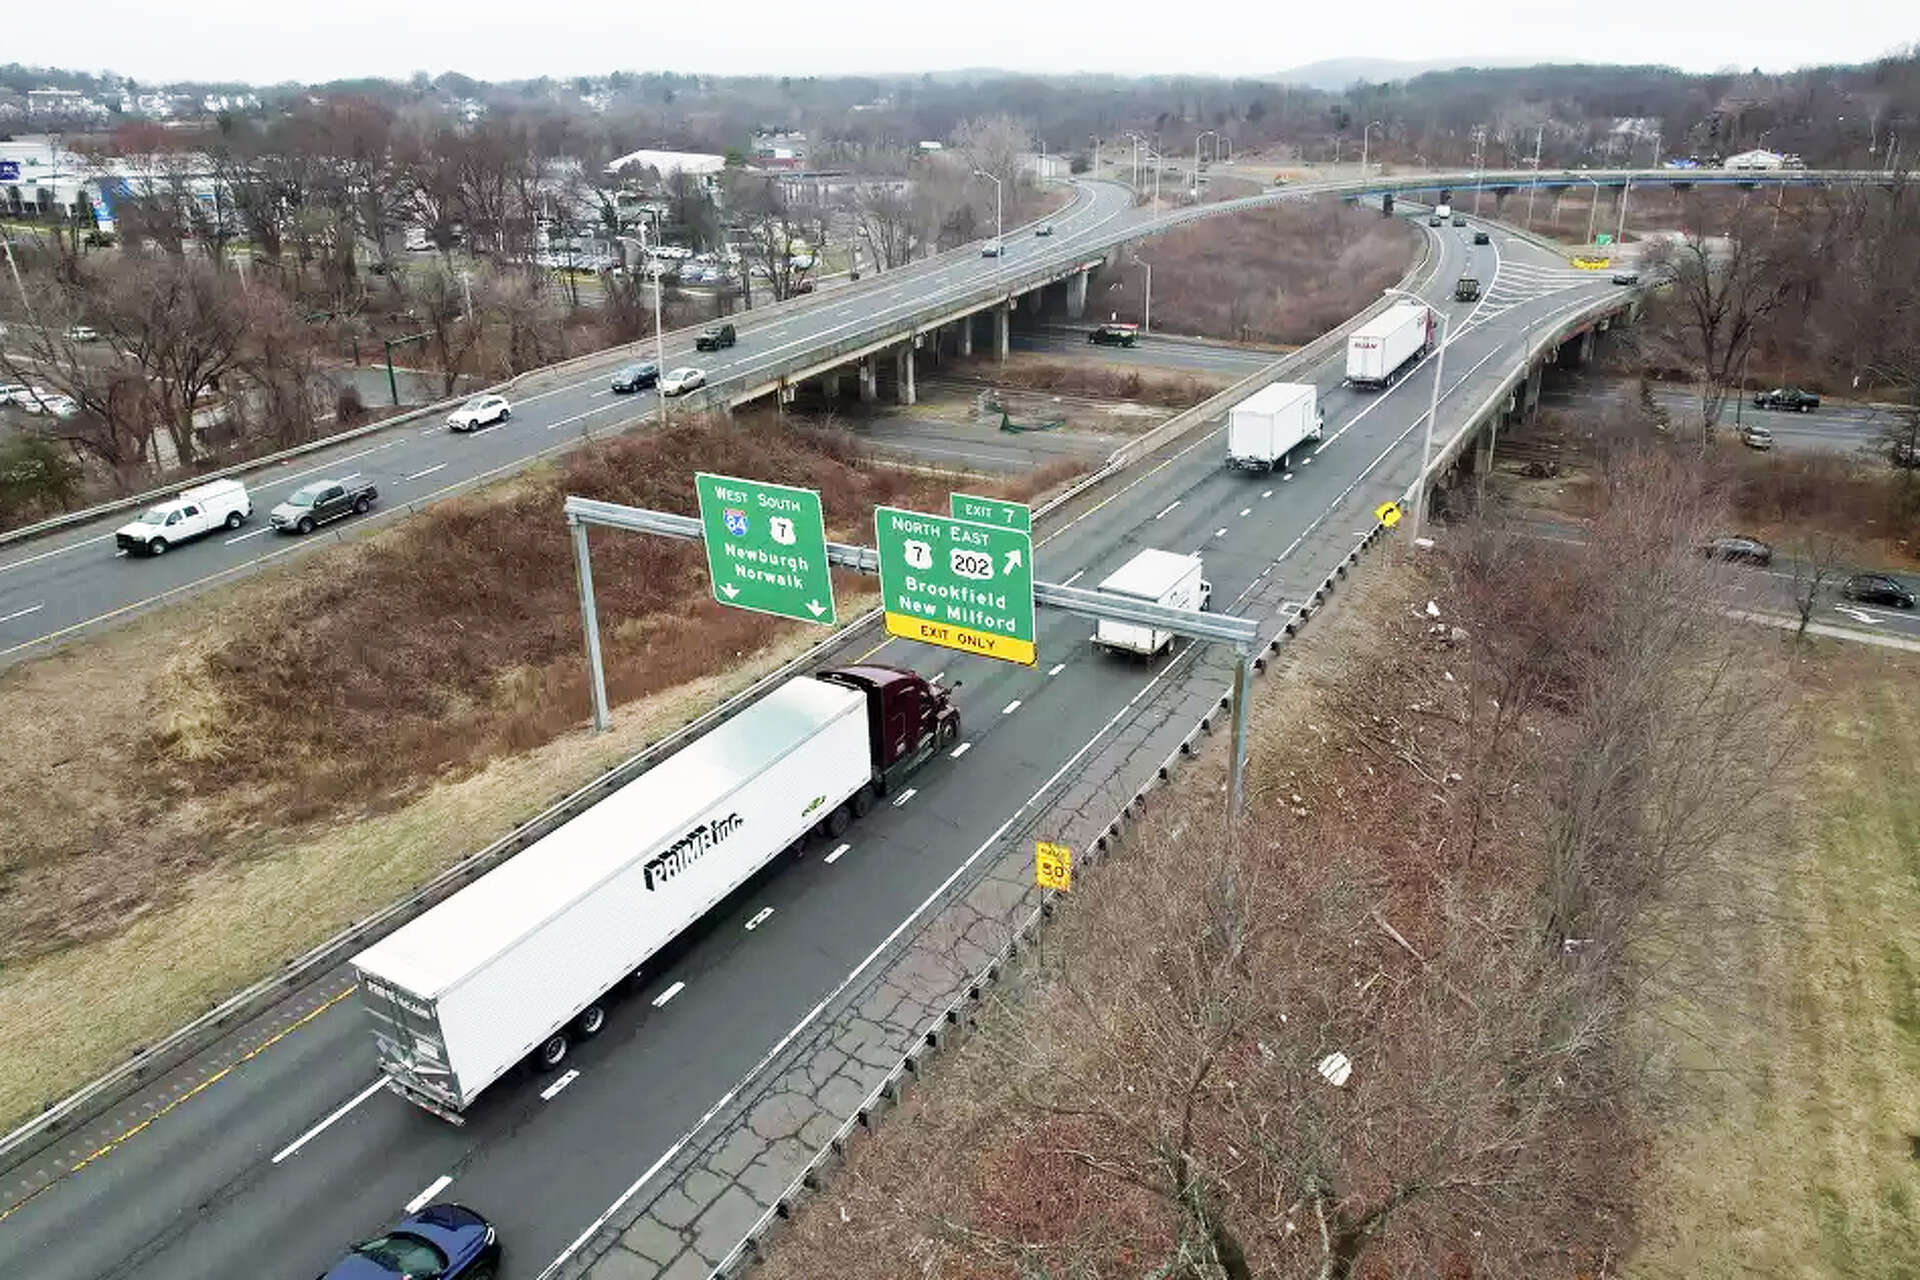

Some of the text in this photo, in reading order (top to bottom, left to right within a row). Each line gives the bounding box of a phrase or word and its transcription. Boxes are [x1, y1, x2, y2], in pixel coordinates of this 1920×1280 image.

[715, 486, 801, 511] WEST SOUTH
[727, 515, 746, 529] 84
[965, 503, 1015, 523] EXIT 7
[892, 516, 989, 546] NORTH EAST
[724, 542, 809, 572] Newburgh
[913, 546, 922, 562] 7
[955, 554, 990, 576] 202
[735, 564, 804, 589] Norwalk
[905, 576, 1006, 609] Brookfield
[899, 595, 1016, 633] New Milford
[920, 625, 995, 650] EXIT ONLY
